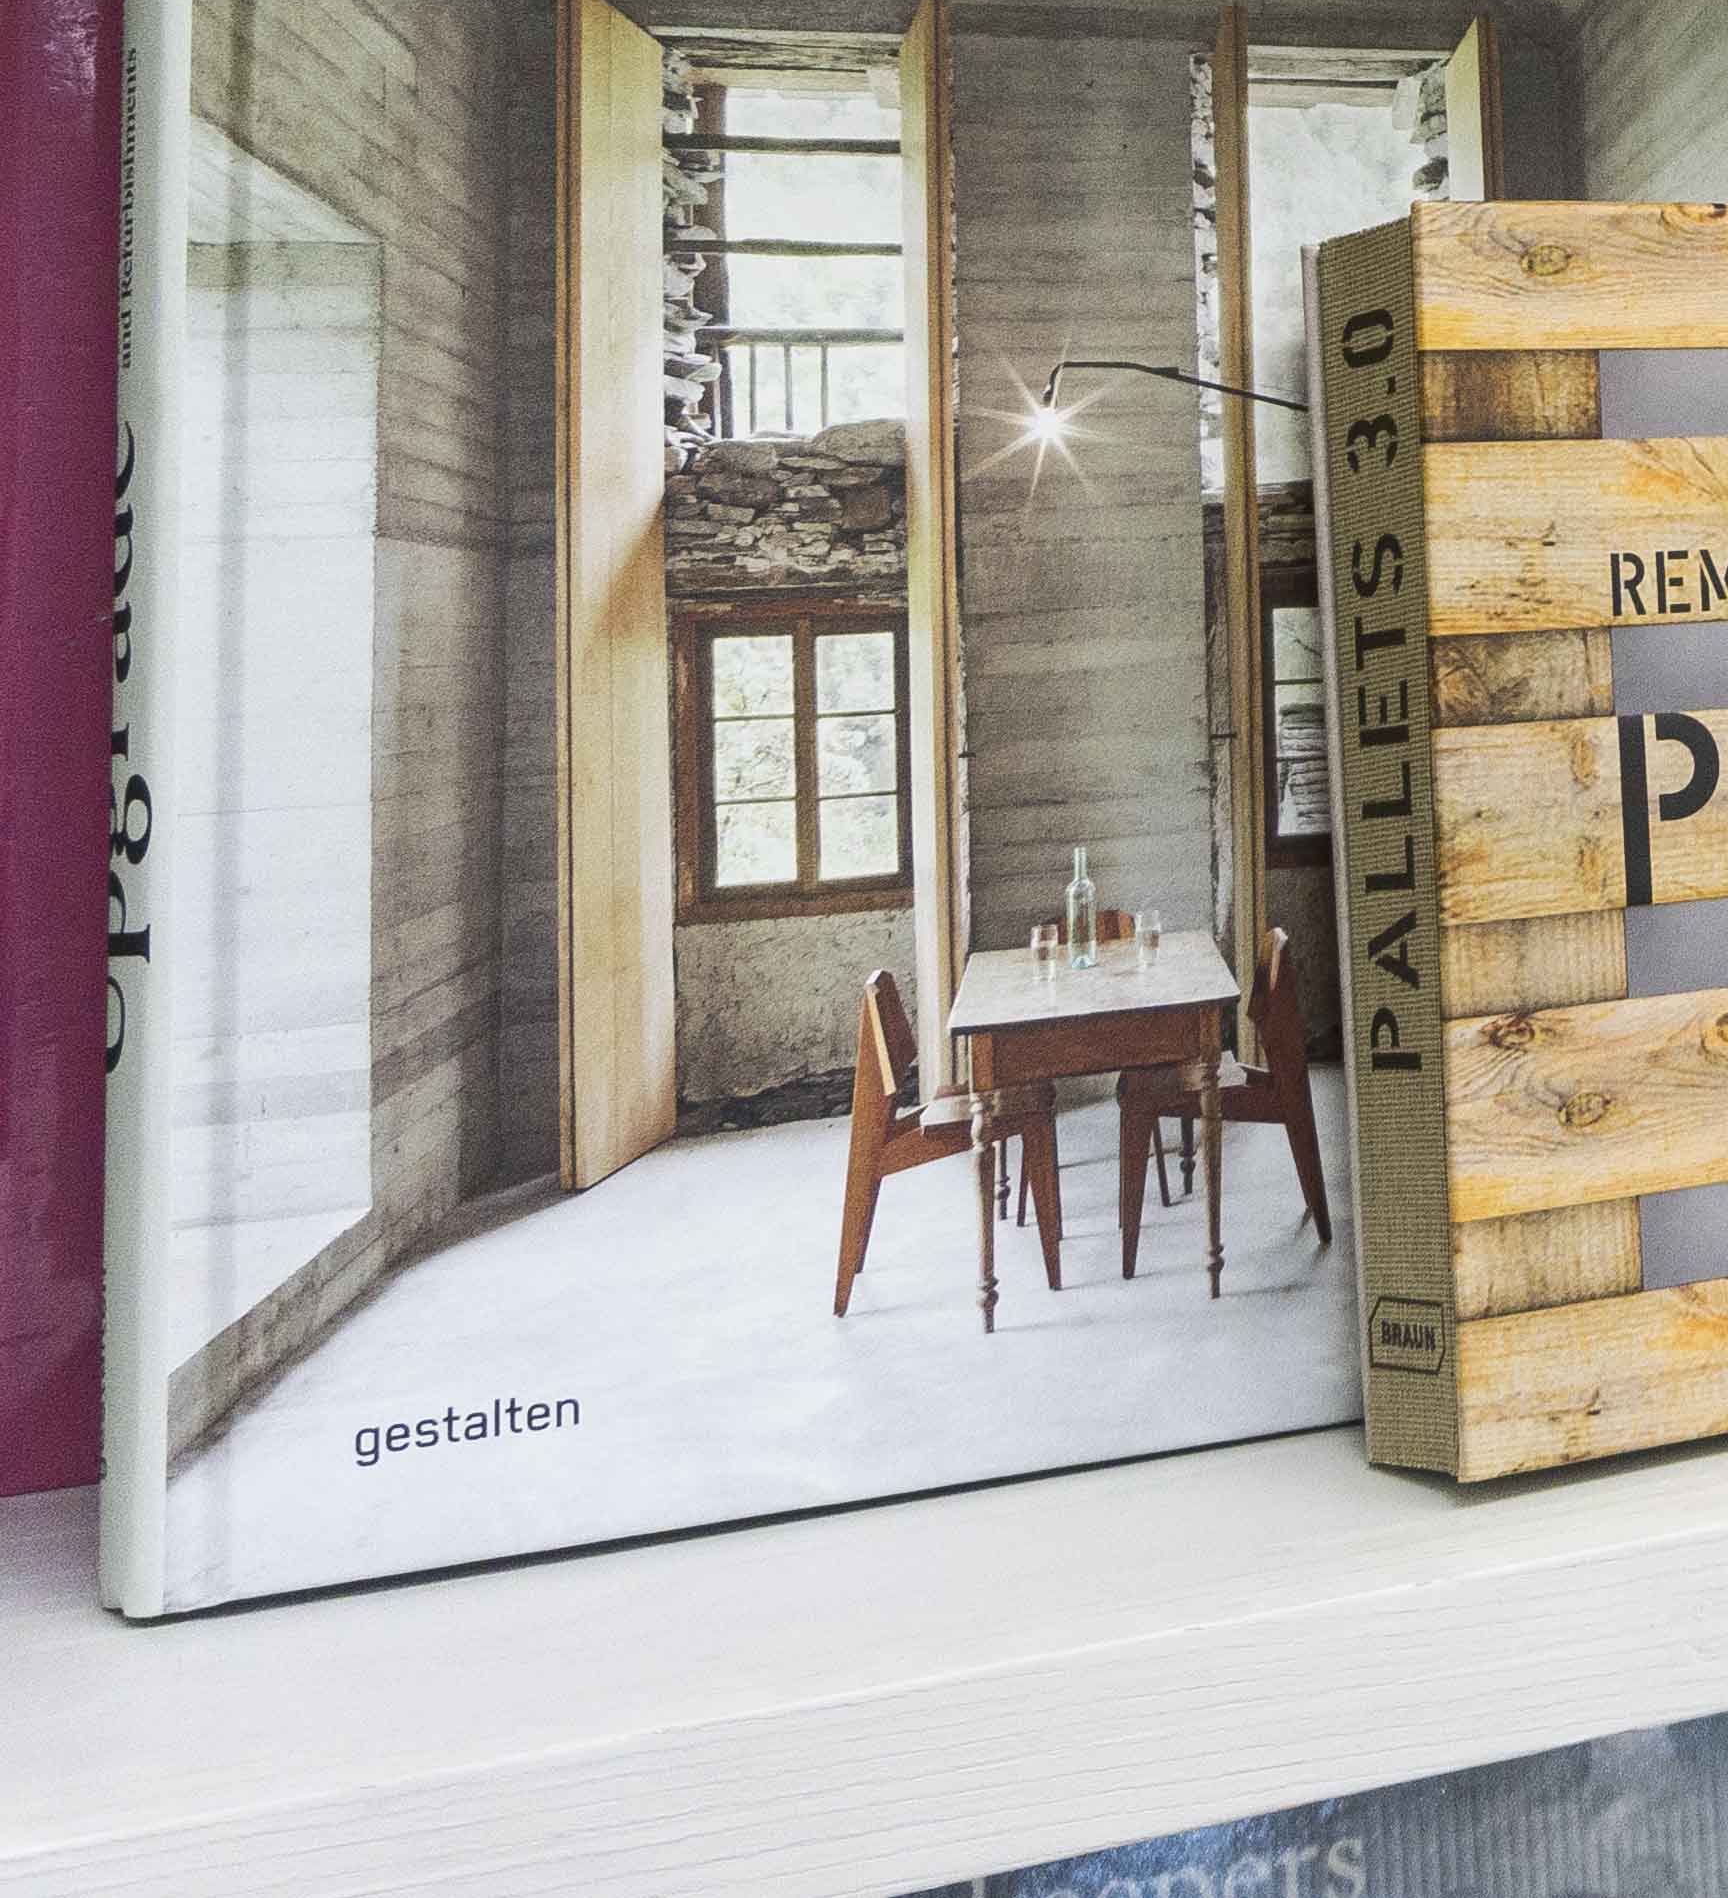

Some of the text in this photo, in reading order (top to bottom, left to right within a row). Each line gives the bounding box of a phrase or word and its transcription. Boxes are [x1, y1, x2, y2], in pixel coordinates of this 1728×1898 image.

[1343, 307, 1422, 1073] PALLETS 3.0
[1379, 1319, 1437, 1352] BRAUN
[355, 1396, 580, 1467] gestalten
